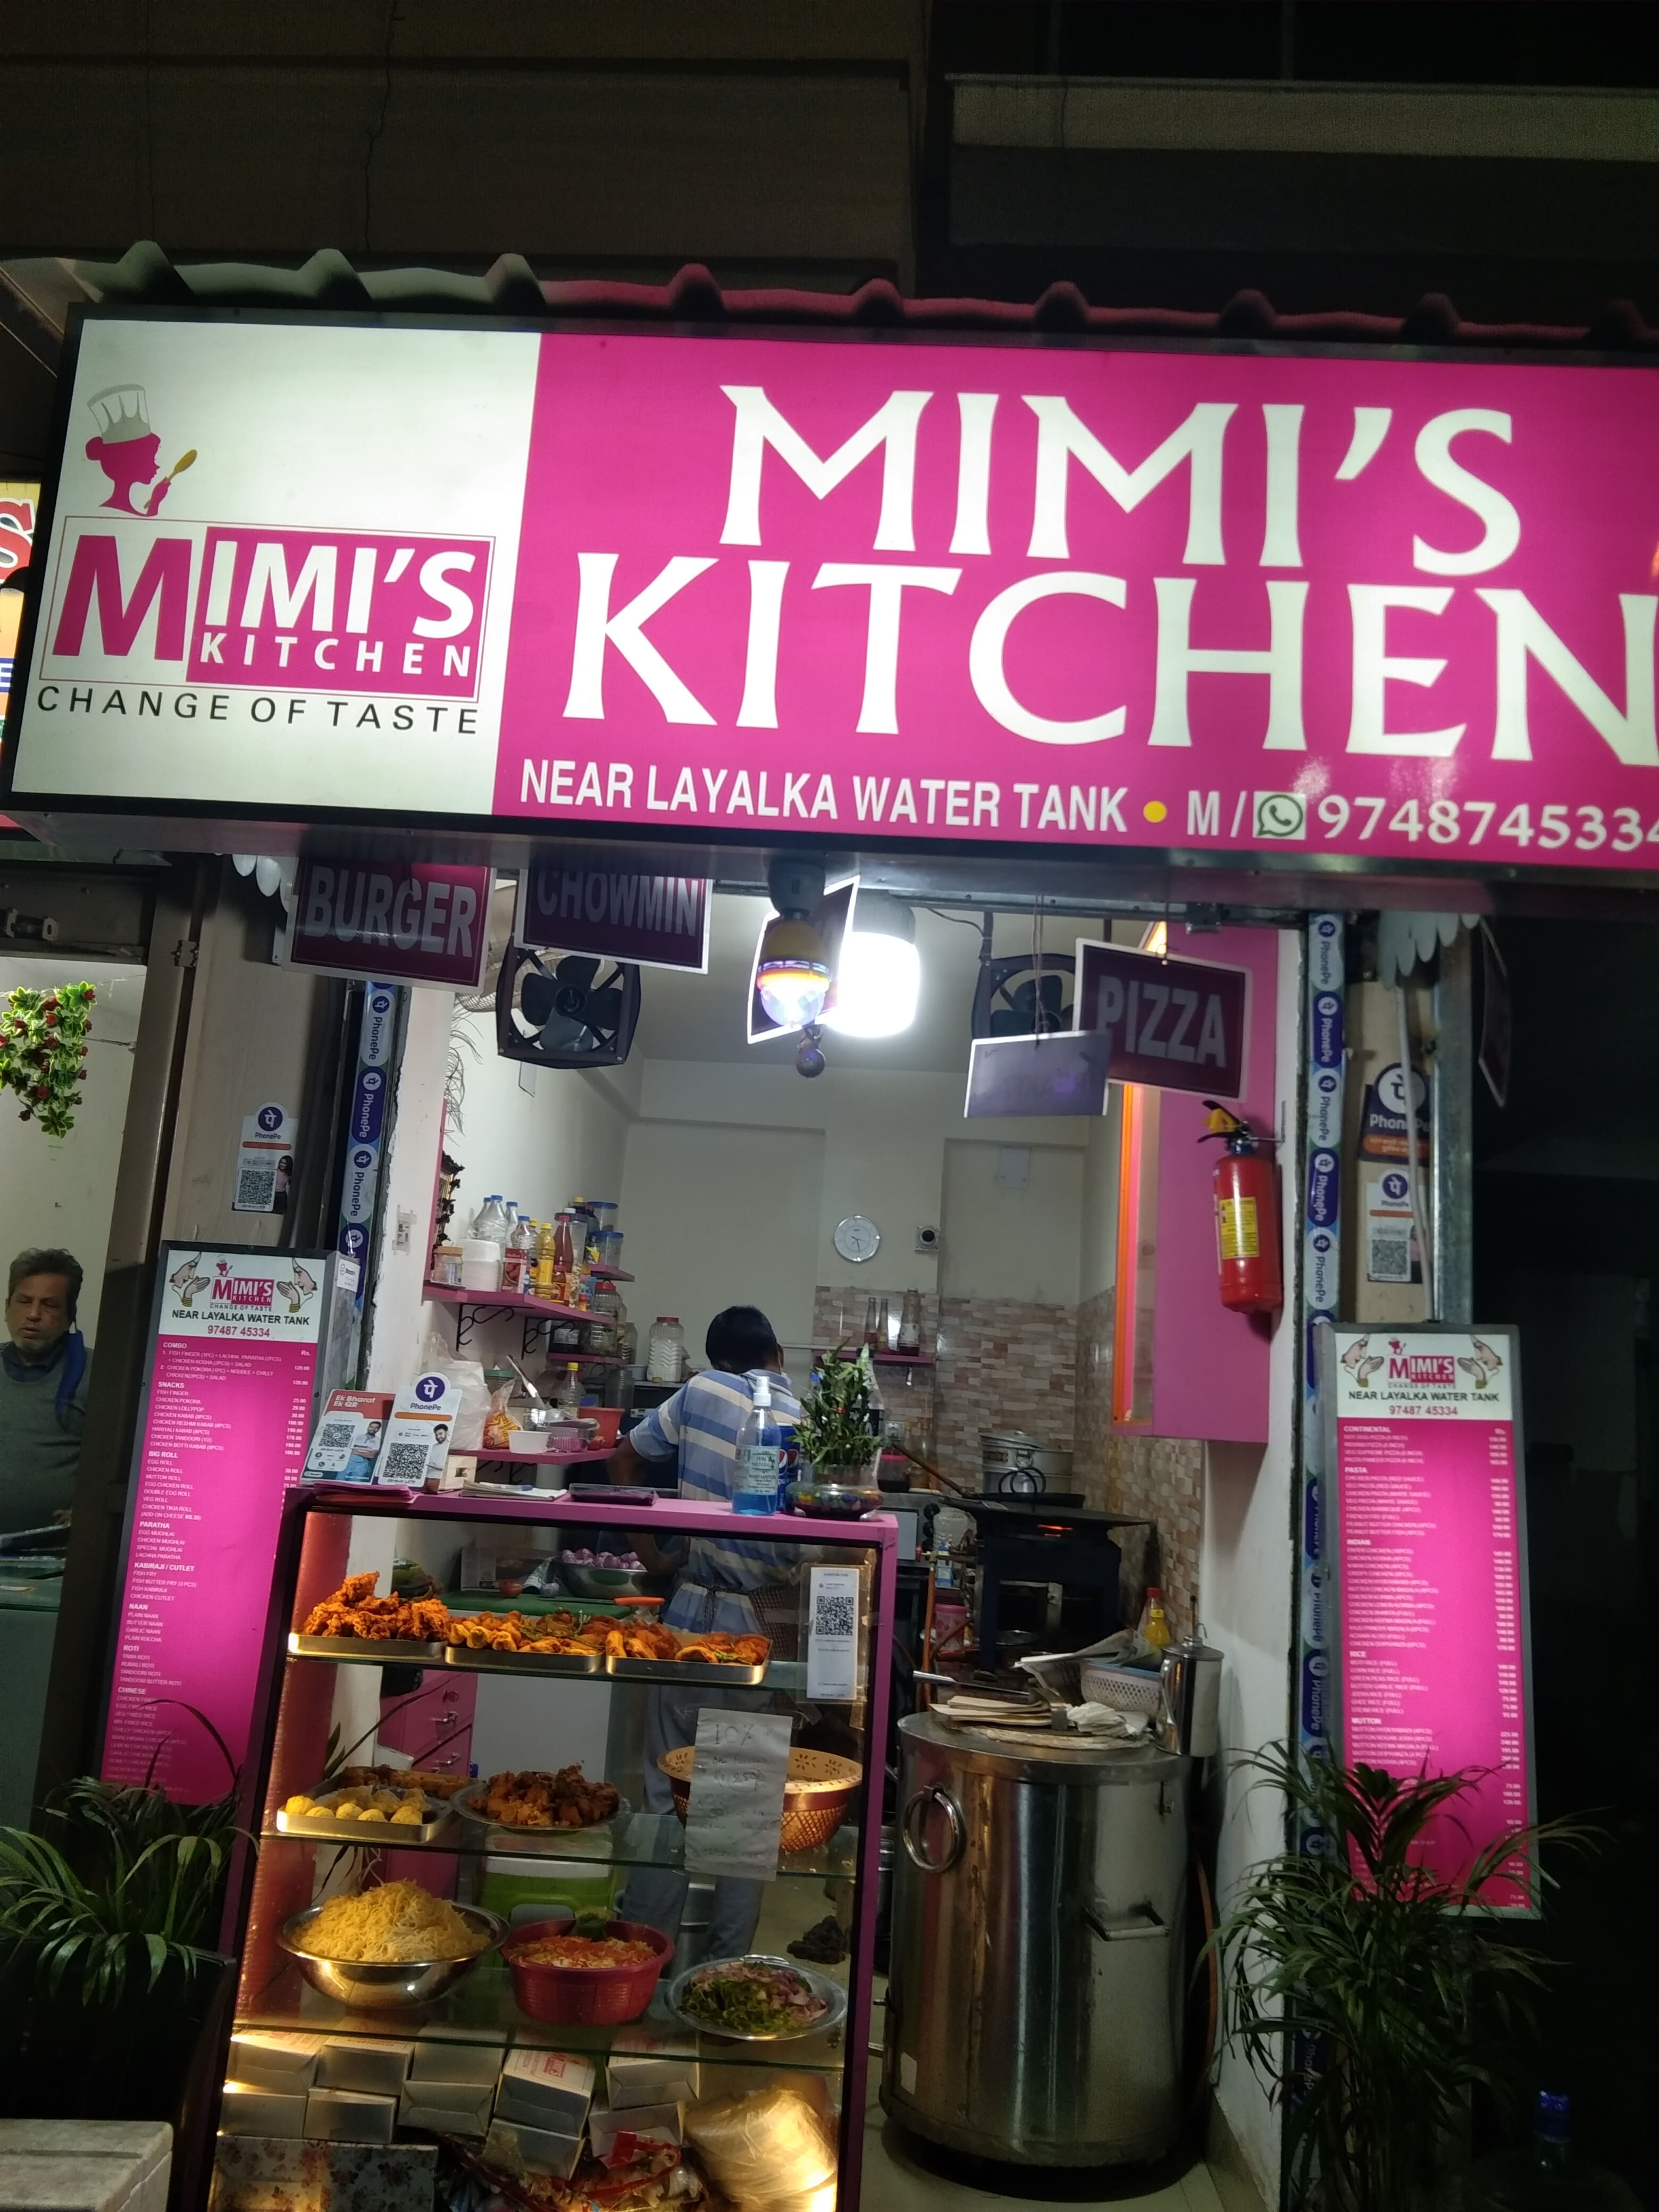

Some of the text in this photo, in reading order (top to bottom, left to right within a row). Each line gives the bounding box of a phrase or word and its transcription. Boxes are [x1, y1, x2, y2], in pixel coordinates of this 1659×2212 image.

[719, 384, 1520, 575] MIMI'S
[52, 534, 476, 661] MIMI'S
[200, 633, 471, 677] KITCHEN
[562, 552, 1658, 767] KITCHEN
[37, 686, 478, 734] CHANGE OF TASTE
[520, 759, 633, 808] NEAR
[647, 765, 837, 819] LAYALKA
[853, 775, 1000, 827] WATER
[1013, 784, 1128, 832] TANK
[304, 866, 477, 957] BURGER
[537, 869, 698, 936] CHOWMIN
[369, 1017, 382, 1060] PhonePe
[1096, 975, 1226, 1068] PIZZA
[1321, 1018, 1331, 1062] PhonePe
[255, 1132, 281, 1140] PhonePe
[359, 1093, 374, 1138] PhonePe
[1319, 1096, 1329, 1141] PhonePe
[1370, 1113, 1430, 1132] PhonPe
[350, 1172, 364, 1217] PhonePe
[1315, 1176, 1327, 1221] PhonePe
[212, 1279, 272, 1300] MIMI'S
[1315, 1256, 1326, 1302] PhonePe
[172, 1310, 310, 1325] NEAR LAYALKA WATER TANK
[207, 1325, 270, 1337] 97487 45334
[1389, 1358, 1453, 1378] MIMI'S
[1381, 1392, 1428, 1400] LAYALKA
[1431, 1393, 1468, 1401] WATER
[1389, 1405, 1457, 1415] 97487 45334
[118, 1686, 147, 1695] CHINESE
